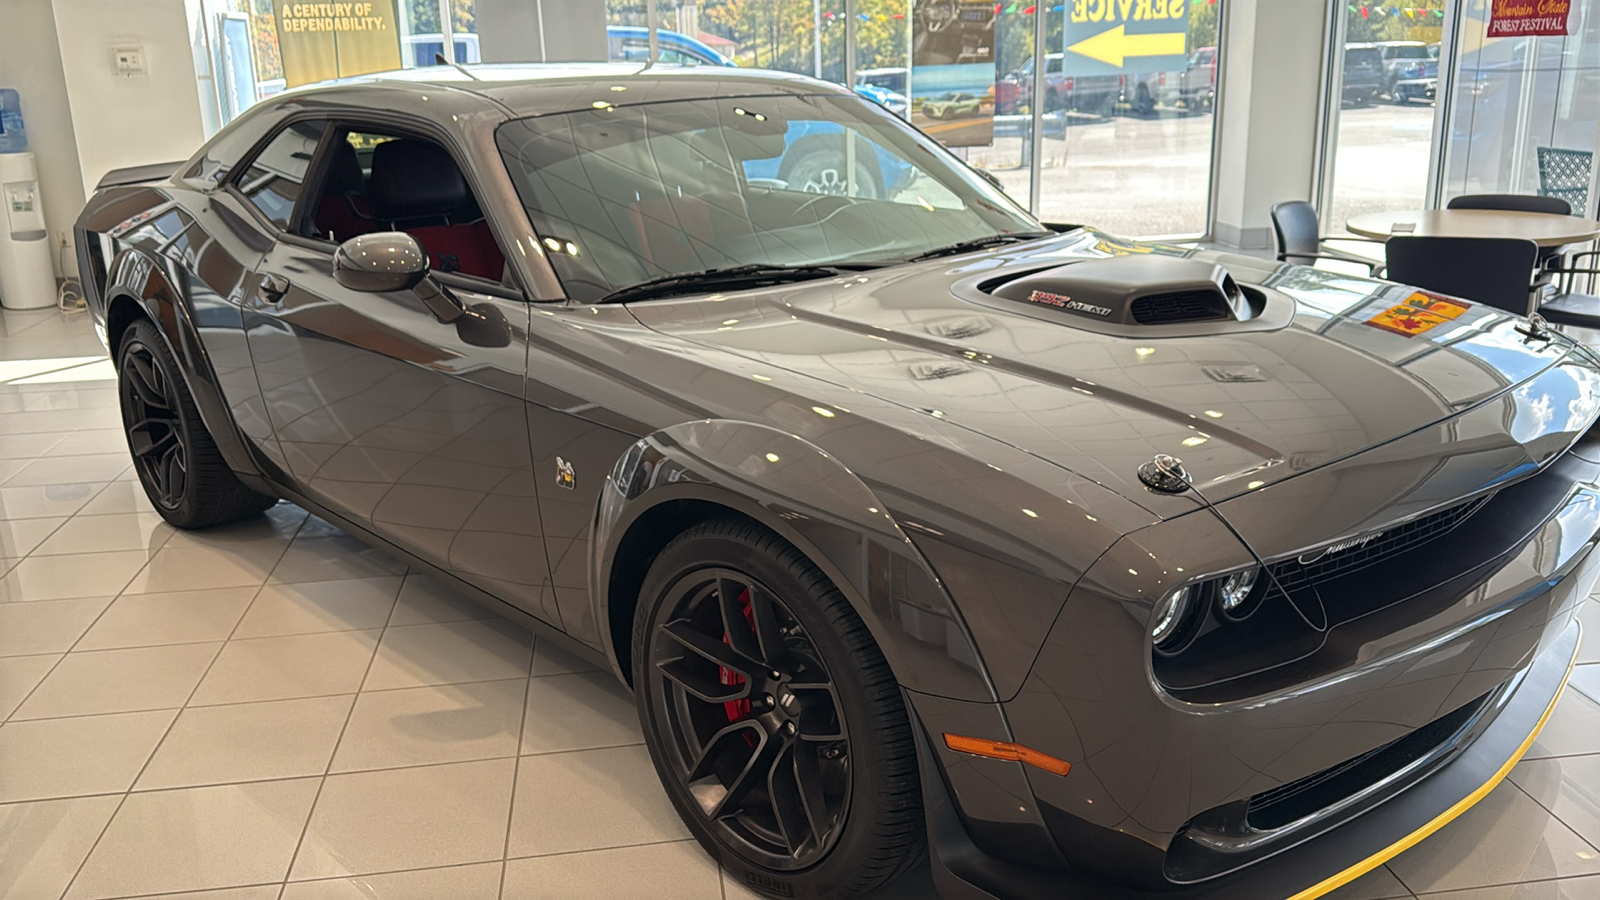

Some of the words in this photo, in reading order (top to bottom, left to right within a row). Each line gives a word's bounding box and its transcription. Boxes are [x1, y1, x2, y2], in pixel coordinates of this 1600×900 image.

[282, 4, 293, 18] A
[293, 3, 353, 18] CENTURY
[354, 3, 372, 17] OF
[282, 17, 387, 32] DEPENDABILITY.
[1492, 19, 1521, 33] FOREST
[1521, 17, 1563, 31] FESTIVAL
